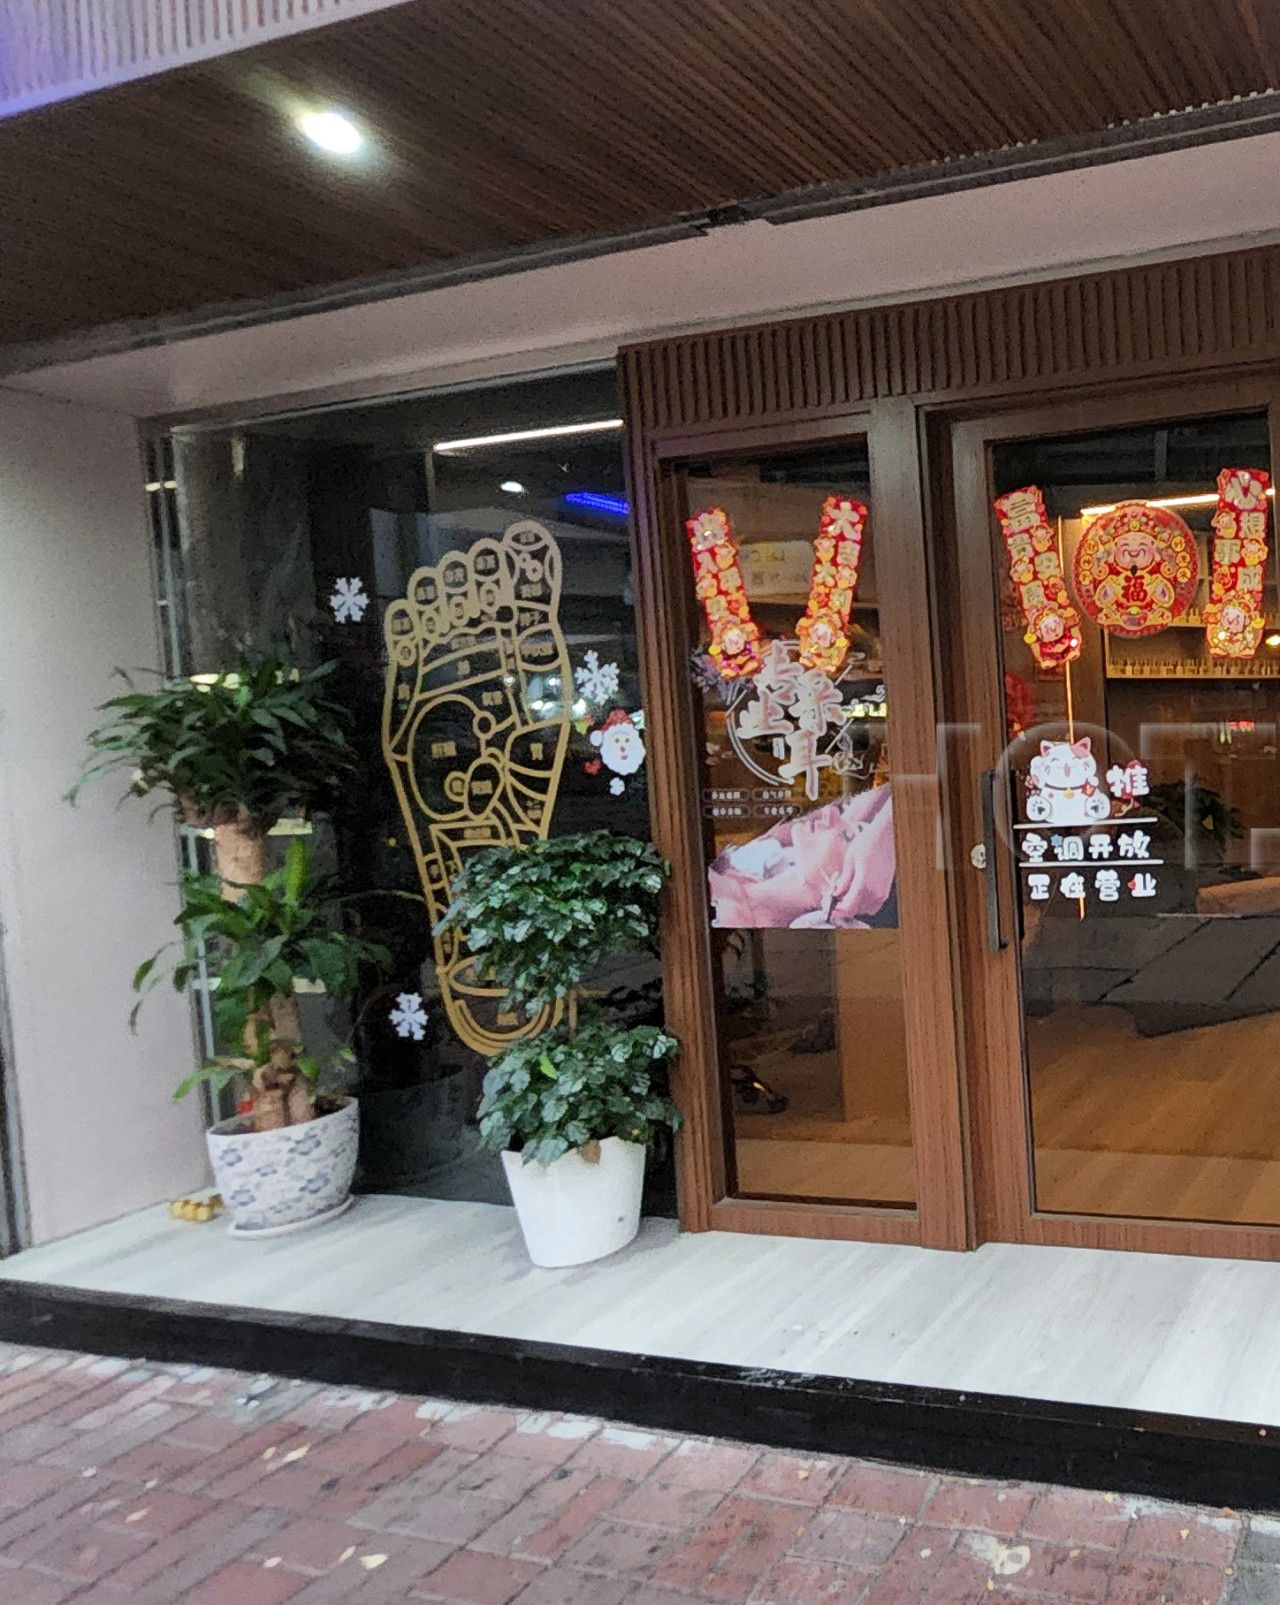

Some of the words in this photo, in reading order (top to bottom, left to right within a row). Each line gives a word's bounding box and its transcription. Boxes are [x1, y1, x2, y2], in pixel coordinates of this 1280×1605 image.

[1106, 765, 1150, 797] 推
[1022, 830, 1151, 863] 空调开放
[1027, 869, 1157, 901] 正在营业
